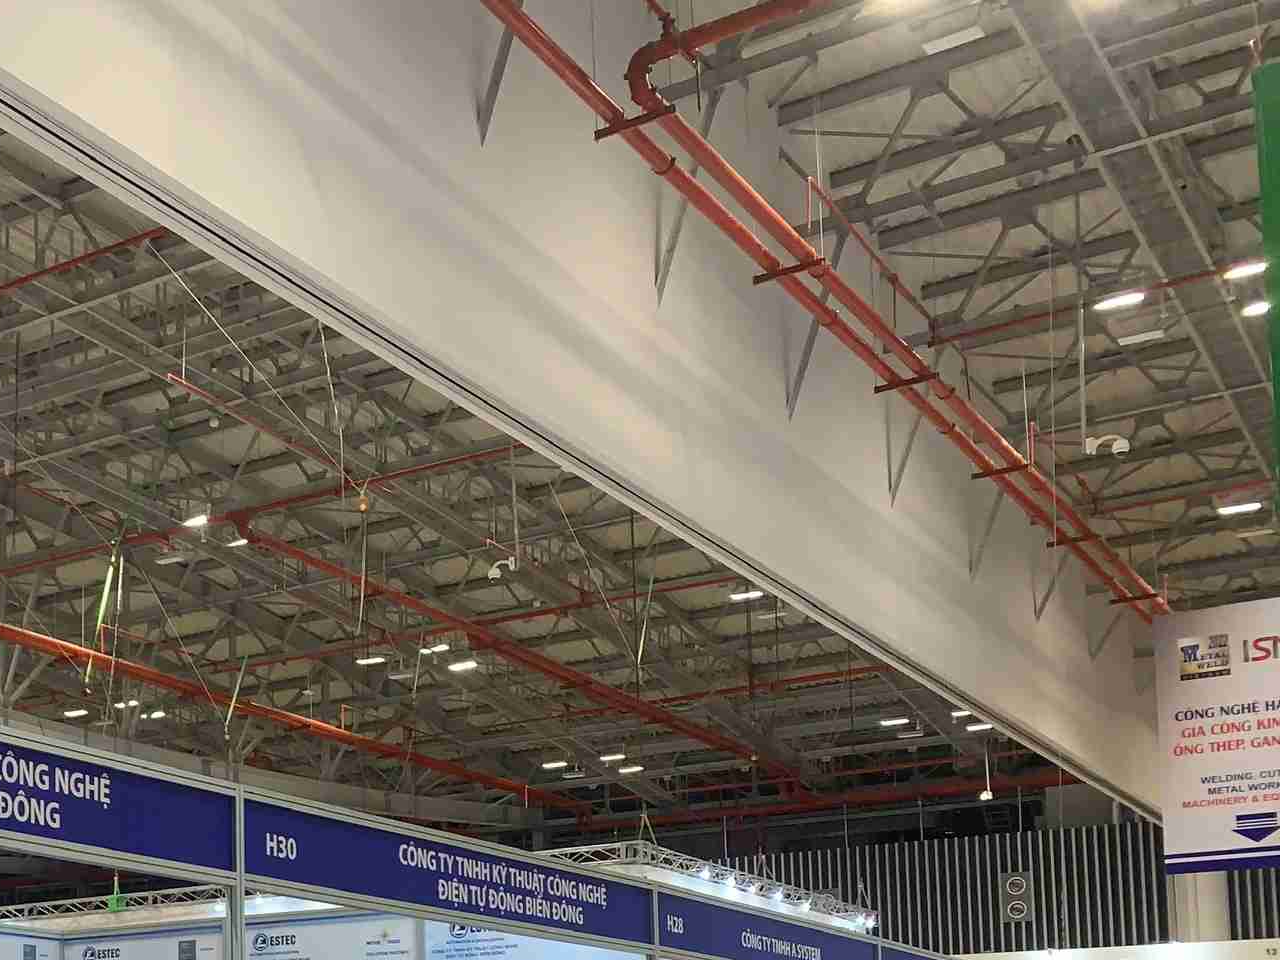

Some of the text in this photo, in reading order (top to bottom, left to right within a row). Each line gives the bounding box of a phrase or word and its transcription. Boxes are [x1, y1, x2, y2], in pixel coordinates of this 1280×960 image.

[54, 765, 112, 809] NGHỆ
[1208, 786, 1246, 795] METAL
[265, 832, 297, 861] H30
[399, 841, 436, 871] CÔNG
[438, 853, 455, 875] TY
[456, 856, 490, 882] TNHH
[509, 868, 545, 895] THUẬT
[547, 875, 577, 899] CÔNG
[579, 883, 608, 910] NGHỆ
[438, 878, 468, 906] ĐIỆN
[470, 885, 487, 911] TỰ
[488, 887, 523, 915] ĐỘNG
[552, 902, 584, 925] ĐÔNG
[667, 914, 684, 934] H28
[269, 933, 297, 946] ESTEC
[741, 929, 761, 952] CÔNG
[97, 947, 120, 960] ESTEC
